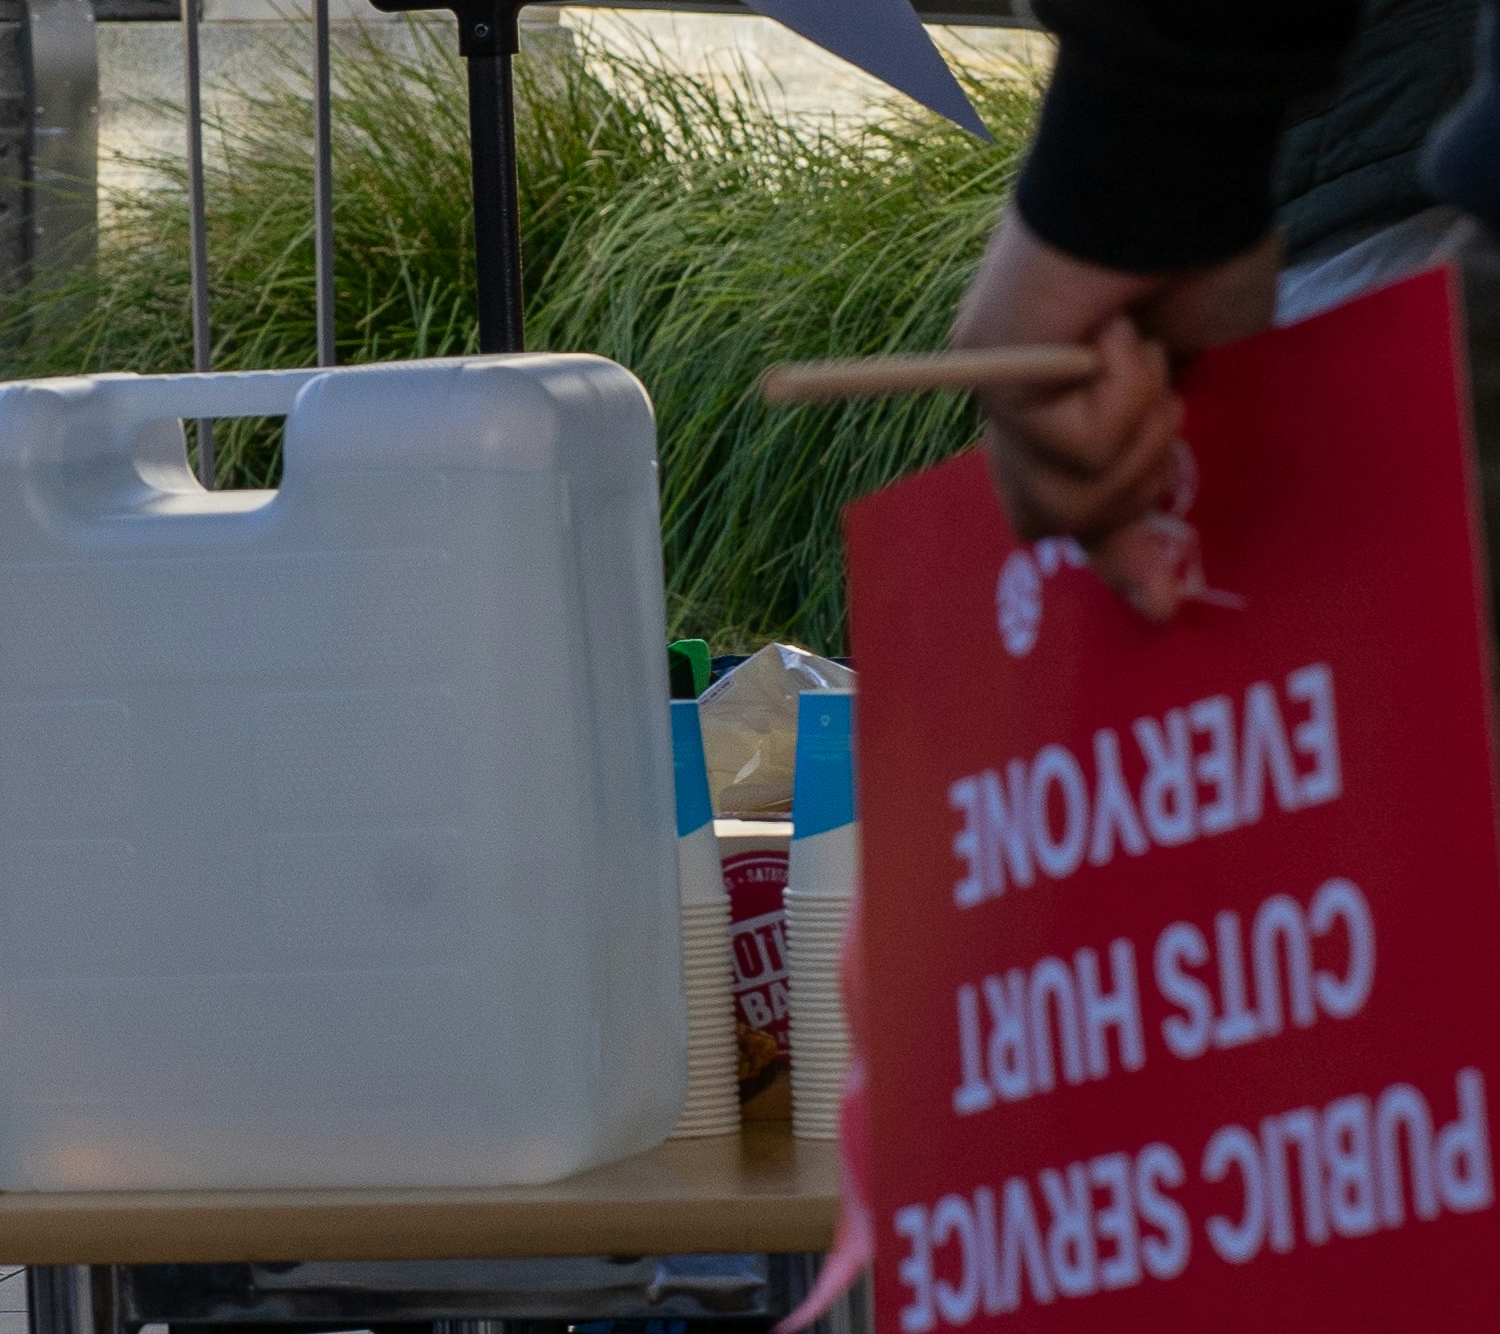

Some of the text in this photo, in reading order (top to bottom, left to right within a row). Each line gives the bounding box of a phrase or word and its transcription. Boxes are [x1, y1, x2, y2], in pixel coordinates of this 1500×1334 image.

[950, 665, 1341, 909] EVERYONE
[732, 920, 788, 983] OT
[953, 879, 1374, 1115] CUTS HURT
[895, 1070, 1493, 1334] PUBLIC SERVICE
